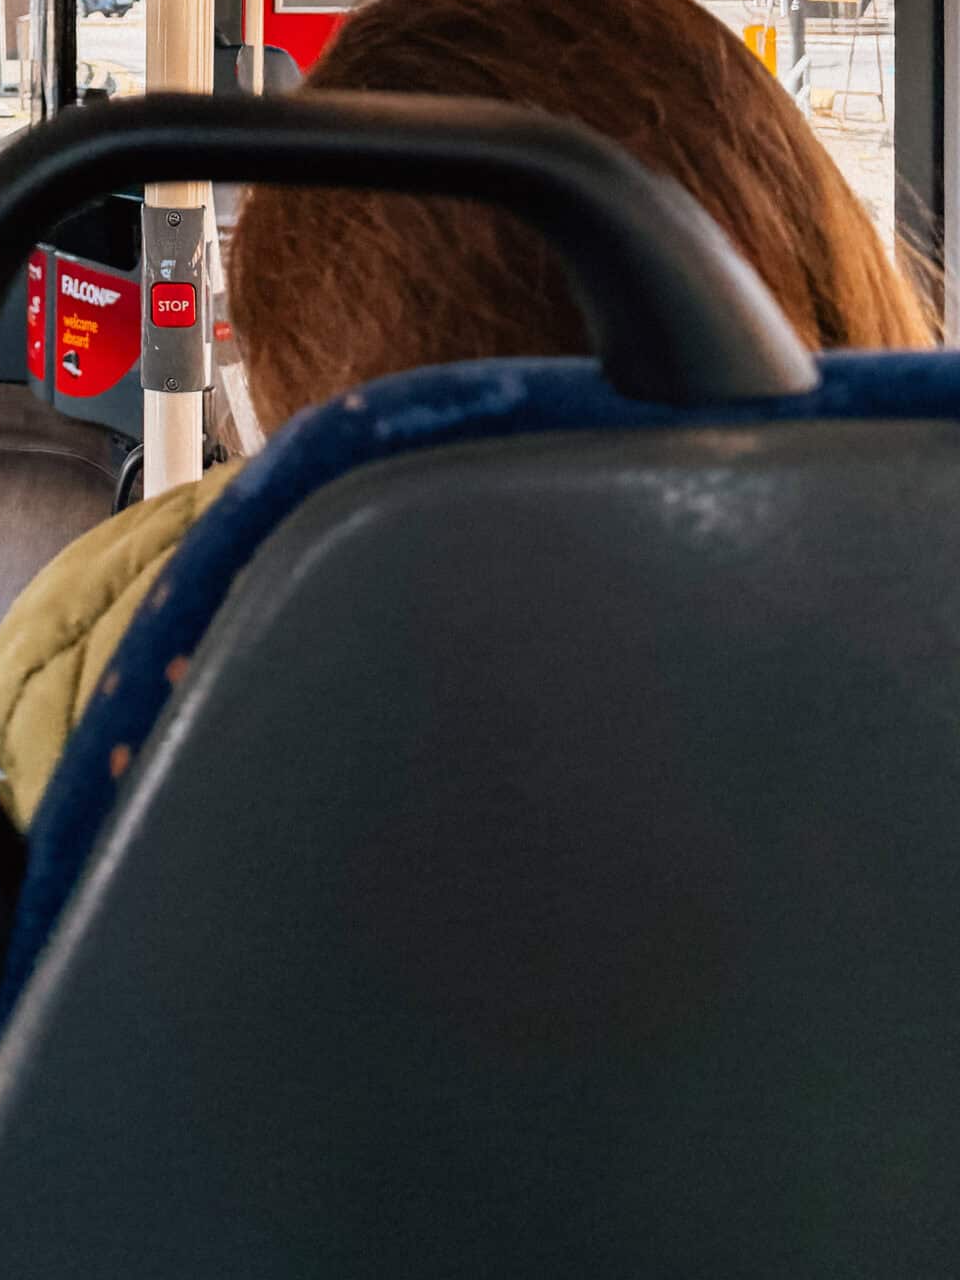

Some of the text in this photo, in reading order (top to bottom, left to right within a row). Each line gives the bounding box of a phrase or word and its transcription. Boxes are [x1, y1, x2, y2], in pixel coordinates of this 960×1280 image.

[61, 274, 112, 307] FALCON
[158, 300, 189, 312] STOP
[63, 313, 98, 334] welcome
